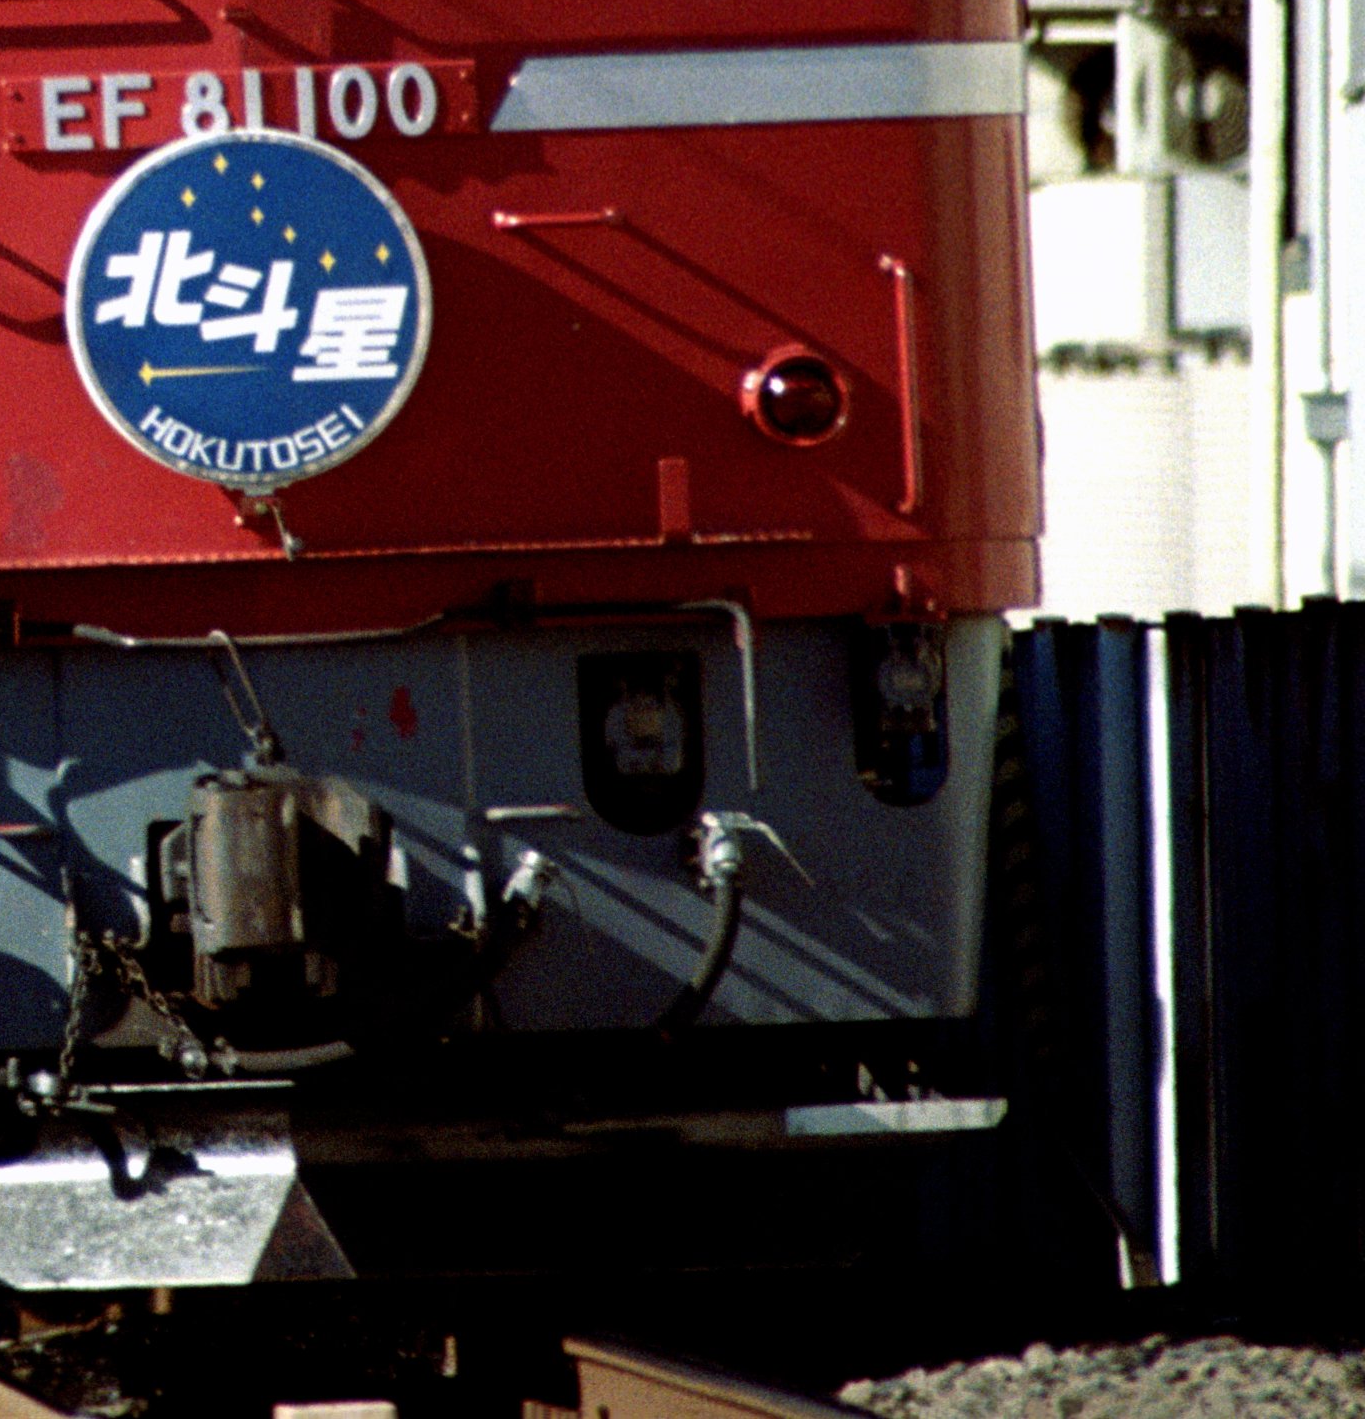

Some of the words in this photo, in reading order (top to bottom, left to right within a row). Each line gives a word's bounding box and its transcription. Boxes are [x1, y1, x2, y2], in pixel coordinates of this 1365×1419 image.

[42, 75, 153, 151] EF
[95, 230, 409, 382] 北斗星
[140, 405, 365, 472] HOKUTOSEI
